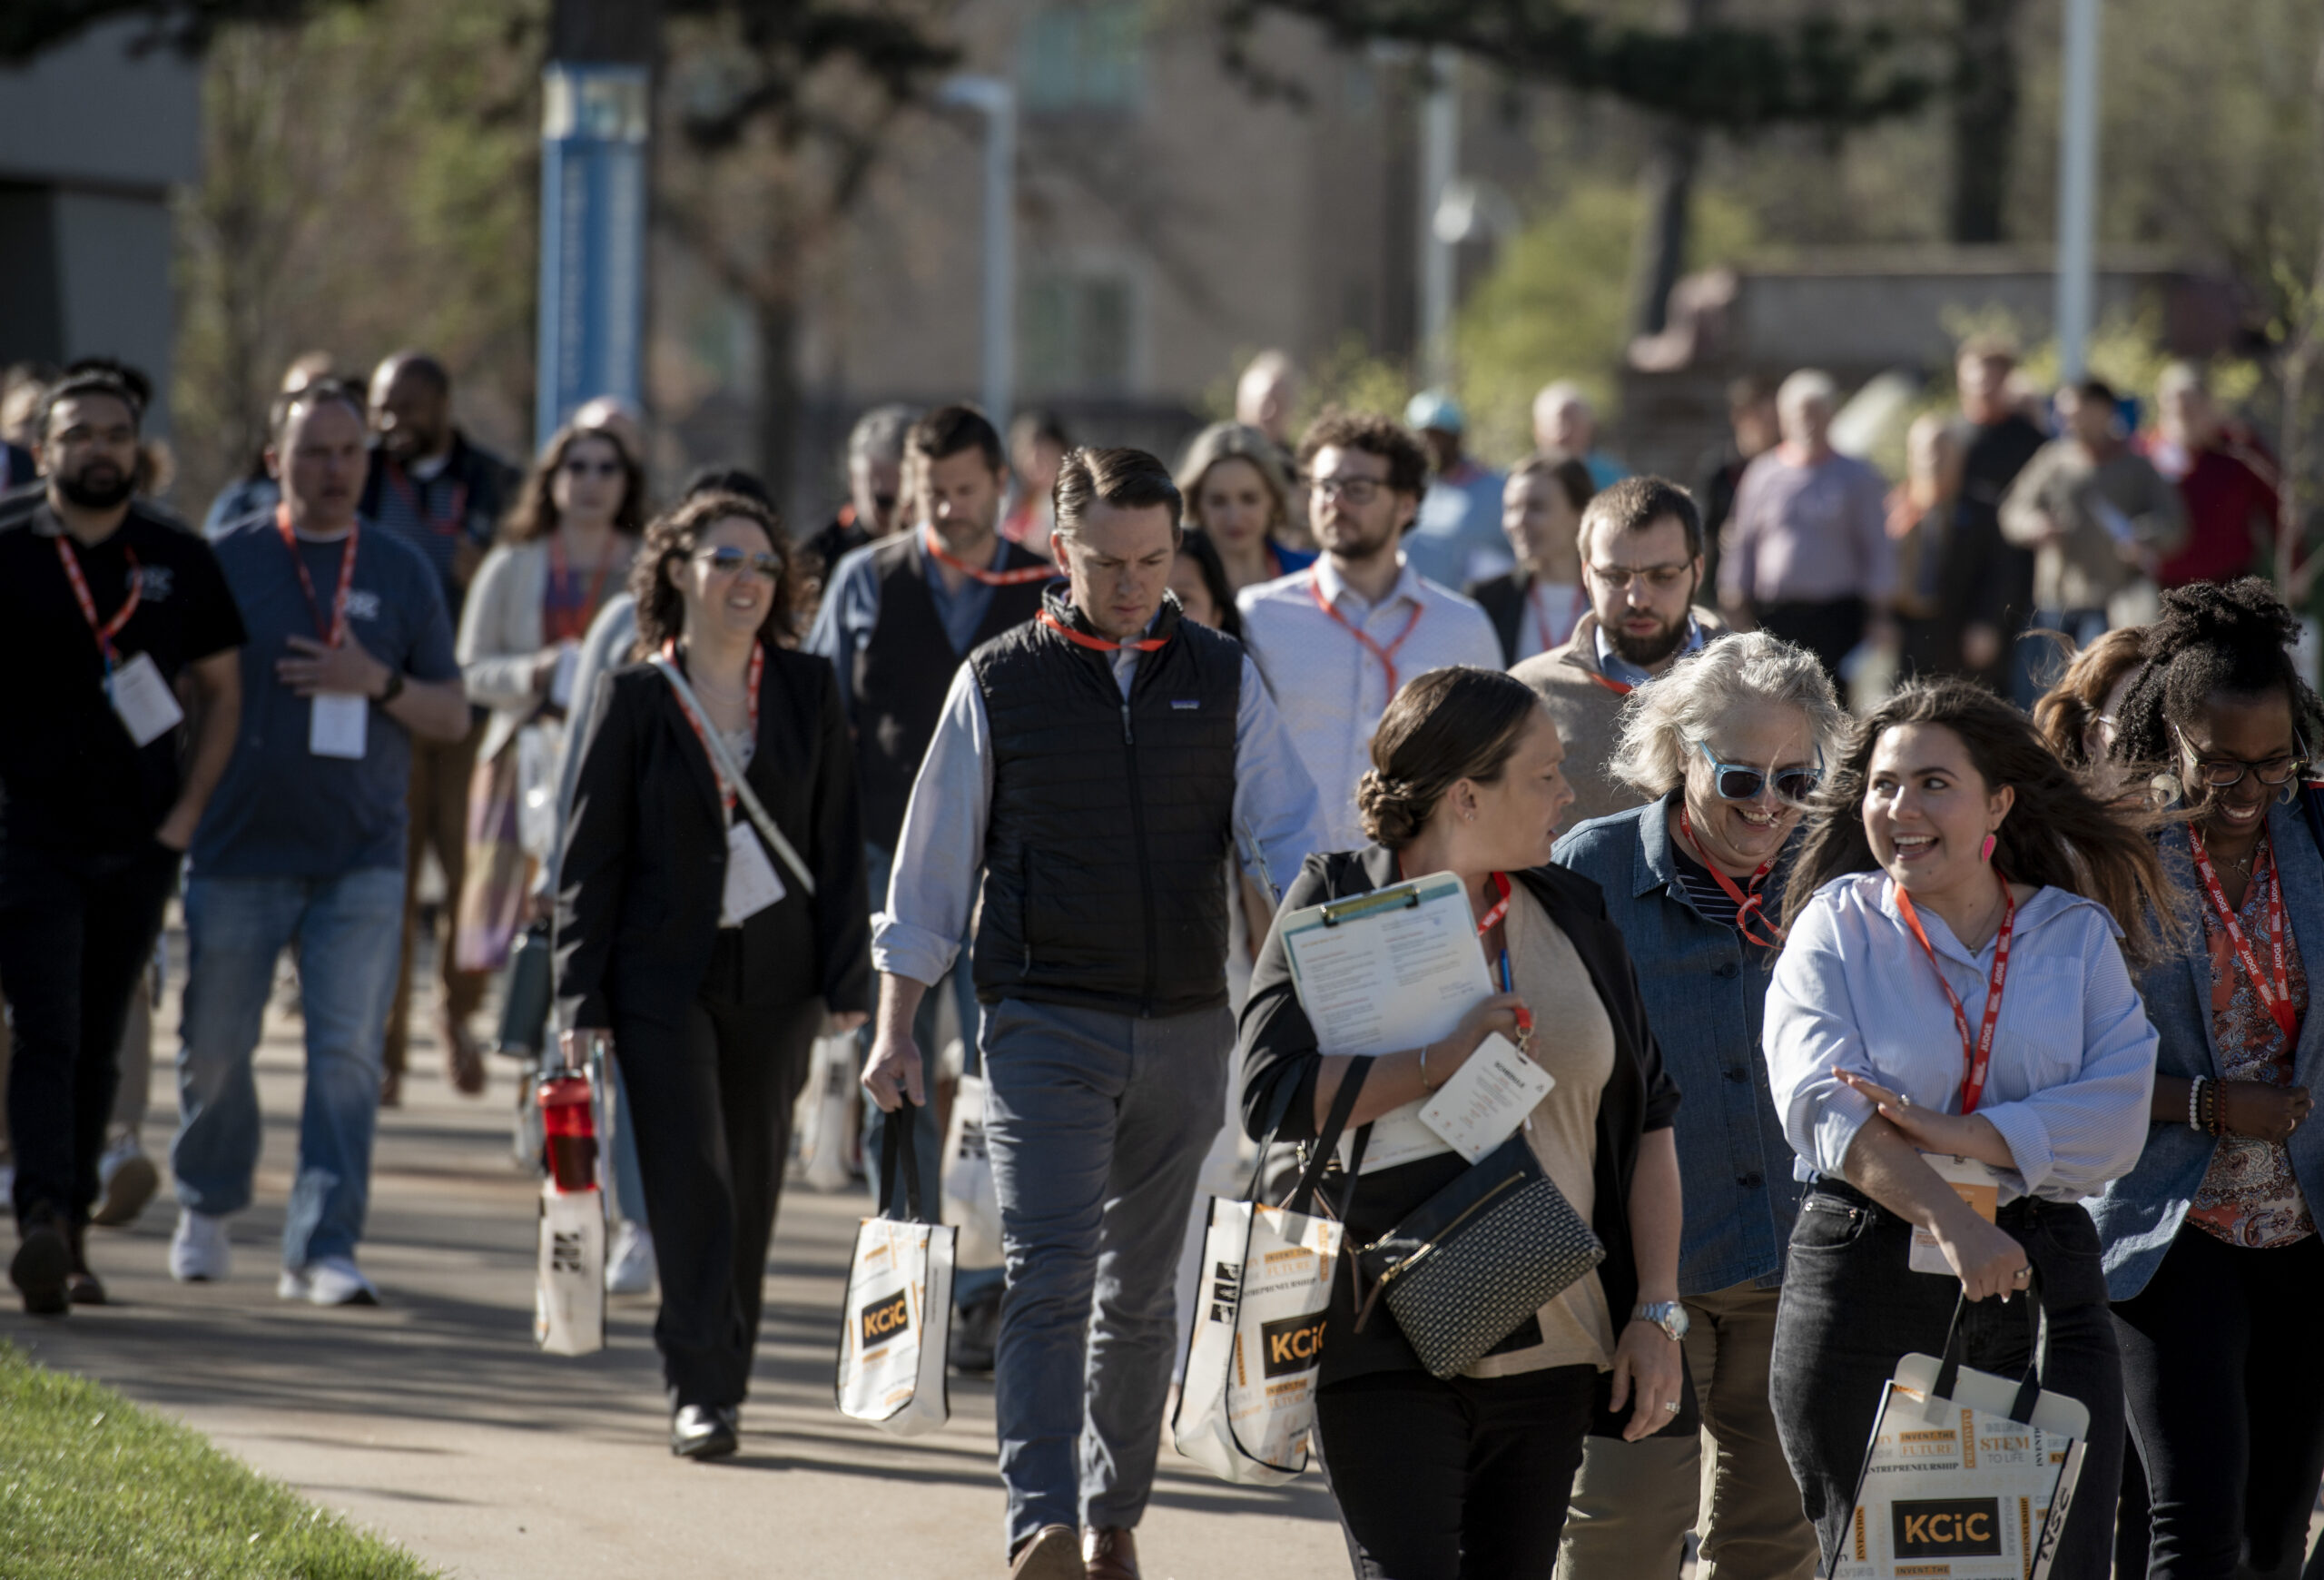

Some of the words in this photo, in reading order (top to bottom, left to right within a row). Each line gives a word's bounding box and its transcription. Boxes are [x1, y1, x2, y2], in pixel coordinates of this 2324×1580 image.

[2212, 889, 2230, 913] JUDGE
[2240, 949, 2260, 976] JUDGE
[2273, 942, 2283, 970] JUDGE
[1980, 1022, 1994, 1052] JUDGE
[864, 1299, 907, 1339] KCiC
[1901, 1432, 1934, 1441] INVENT
[1937, 1430, 1955, 1439] THE
[1980, 1436, 2029, 1452] STEM
[1903, 1444, 1955, 1456] FUTURE
[1988, 1454, 2002, 1464] TO
[2004, 1453, 2025, 1463] LIFE
[1856, 1507, 1866, 1560] INVENTION
[1905, 1512, 1991, 1544] KCiC
